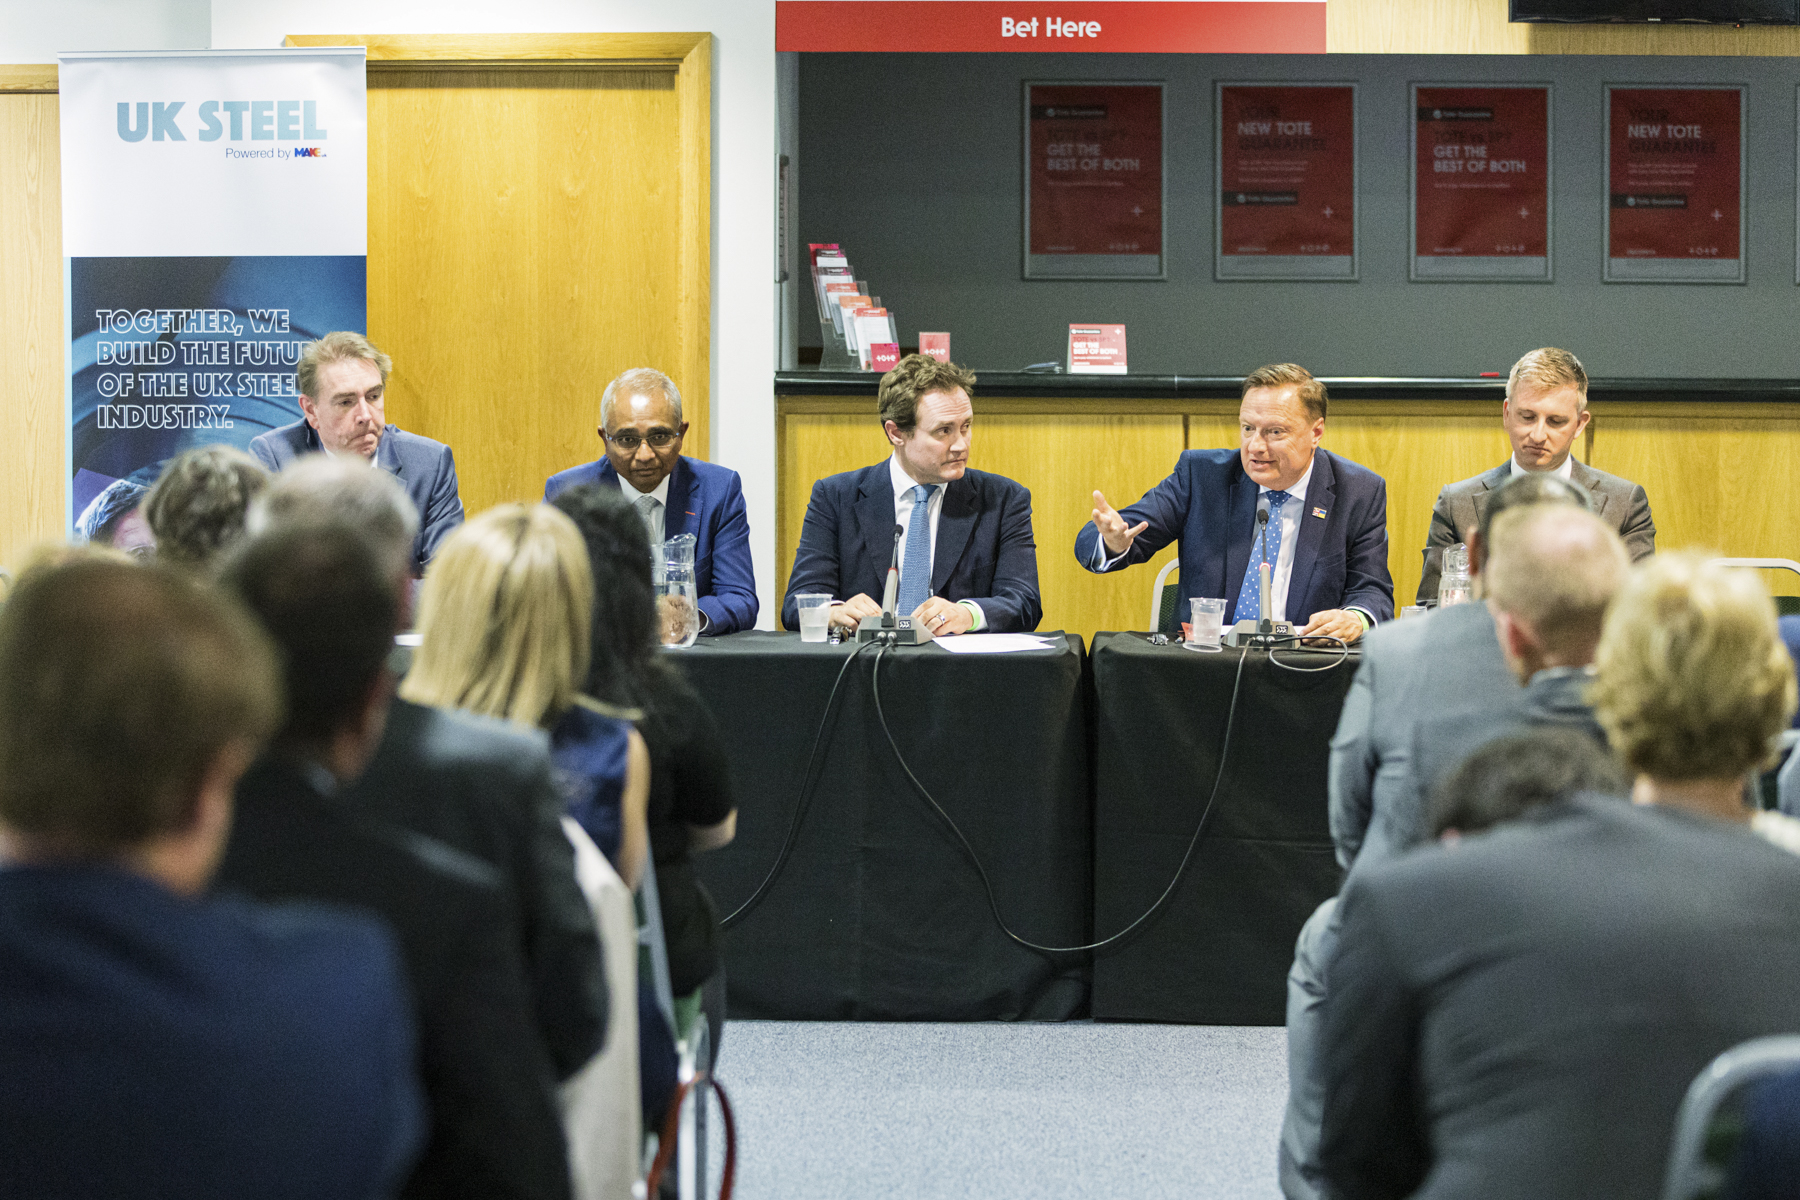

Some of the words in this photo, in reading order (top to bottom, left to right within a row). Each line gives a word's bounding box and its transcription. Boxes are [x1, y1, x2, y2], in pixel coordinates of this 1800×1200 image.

[1001, 16, 1039, 38] Bet
[1045, 16, 1102, 38] Here
[117, 101, 187, 143] UK
[198, 100, 328, 142] STEEL
[1237, 121, 1271, 136] NEW
[1276, 121, 1313, 136] TOTE
[1628, 124, 1661, 138] NEW
[1666, 124, 1702, 138] TOTE
[225, 148, 274, 159] Powered
[277, 148, 291, 161] by
[294, 147, 321, 158] MAKE
[1047, 144, 1074, 156] GET
[1077, 144, 1101, 156] THE
[1433, 145, 1460, 158] GET
[1464, 145, 1487, 158] THE
[1047, 158, 1077, 171] BEST
[1080, 158, 1099, 171] OF
[1103, 158, 1140, 171] BOTH
[1433, 160, 1463, 173] BEST
[1467, 160, 1487, 173] OF
[1489, 160, 1527, 173] BOTH
[96, 309, 244, 336] TOGETHER,
[247, 309, 290, 333] WE
[96, 341, 176, 365] BUILD
[180, 341, 230, 365] THE
[96, 372, 134, 398] OF
[138, 372, 188, 397] THE
[193, 372, 233, 397] UK
[97, 404, 234, 429] INDUSTRY.
